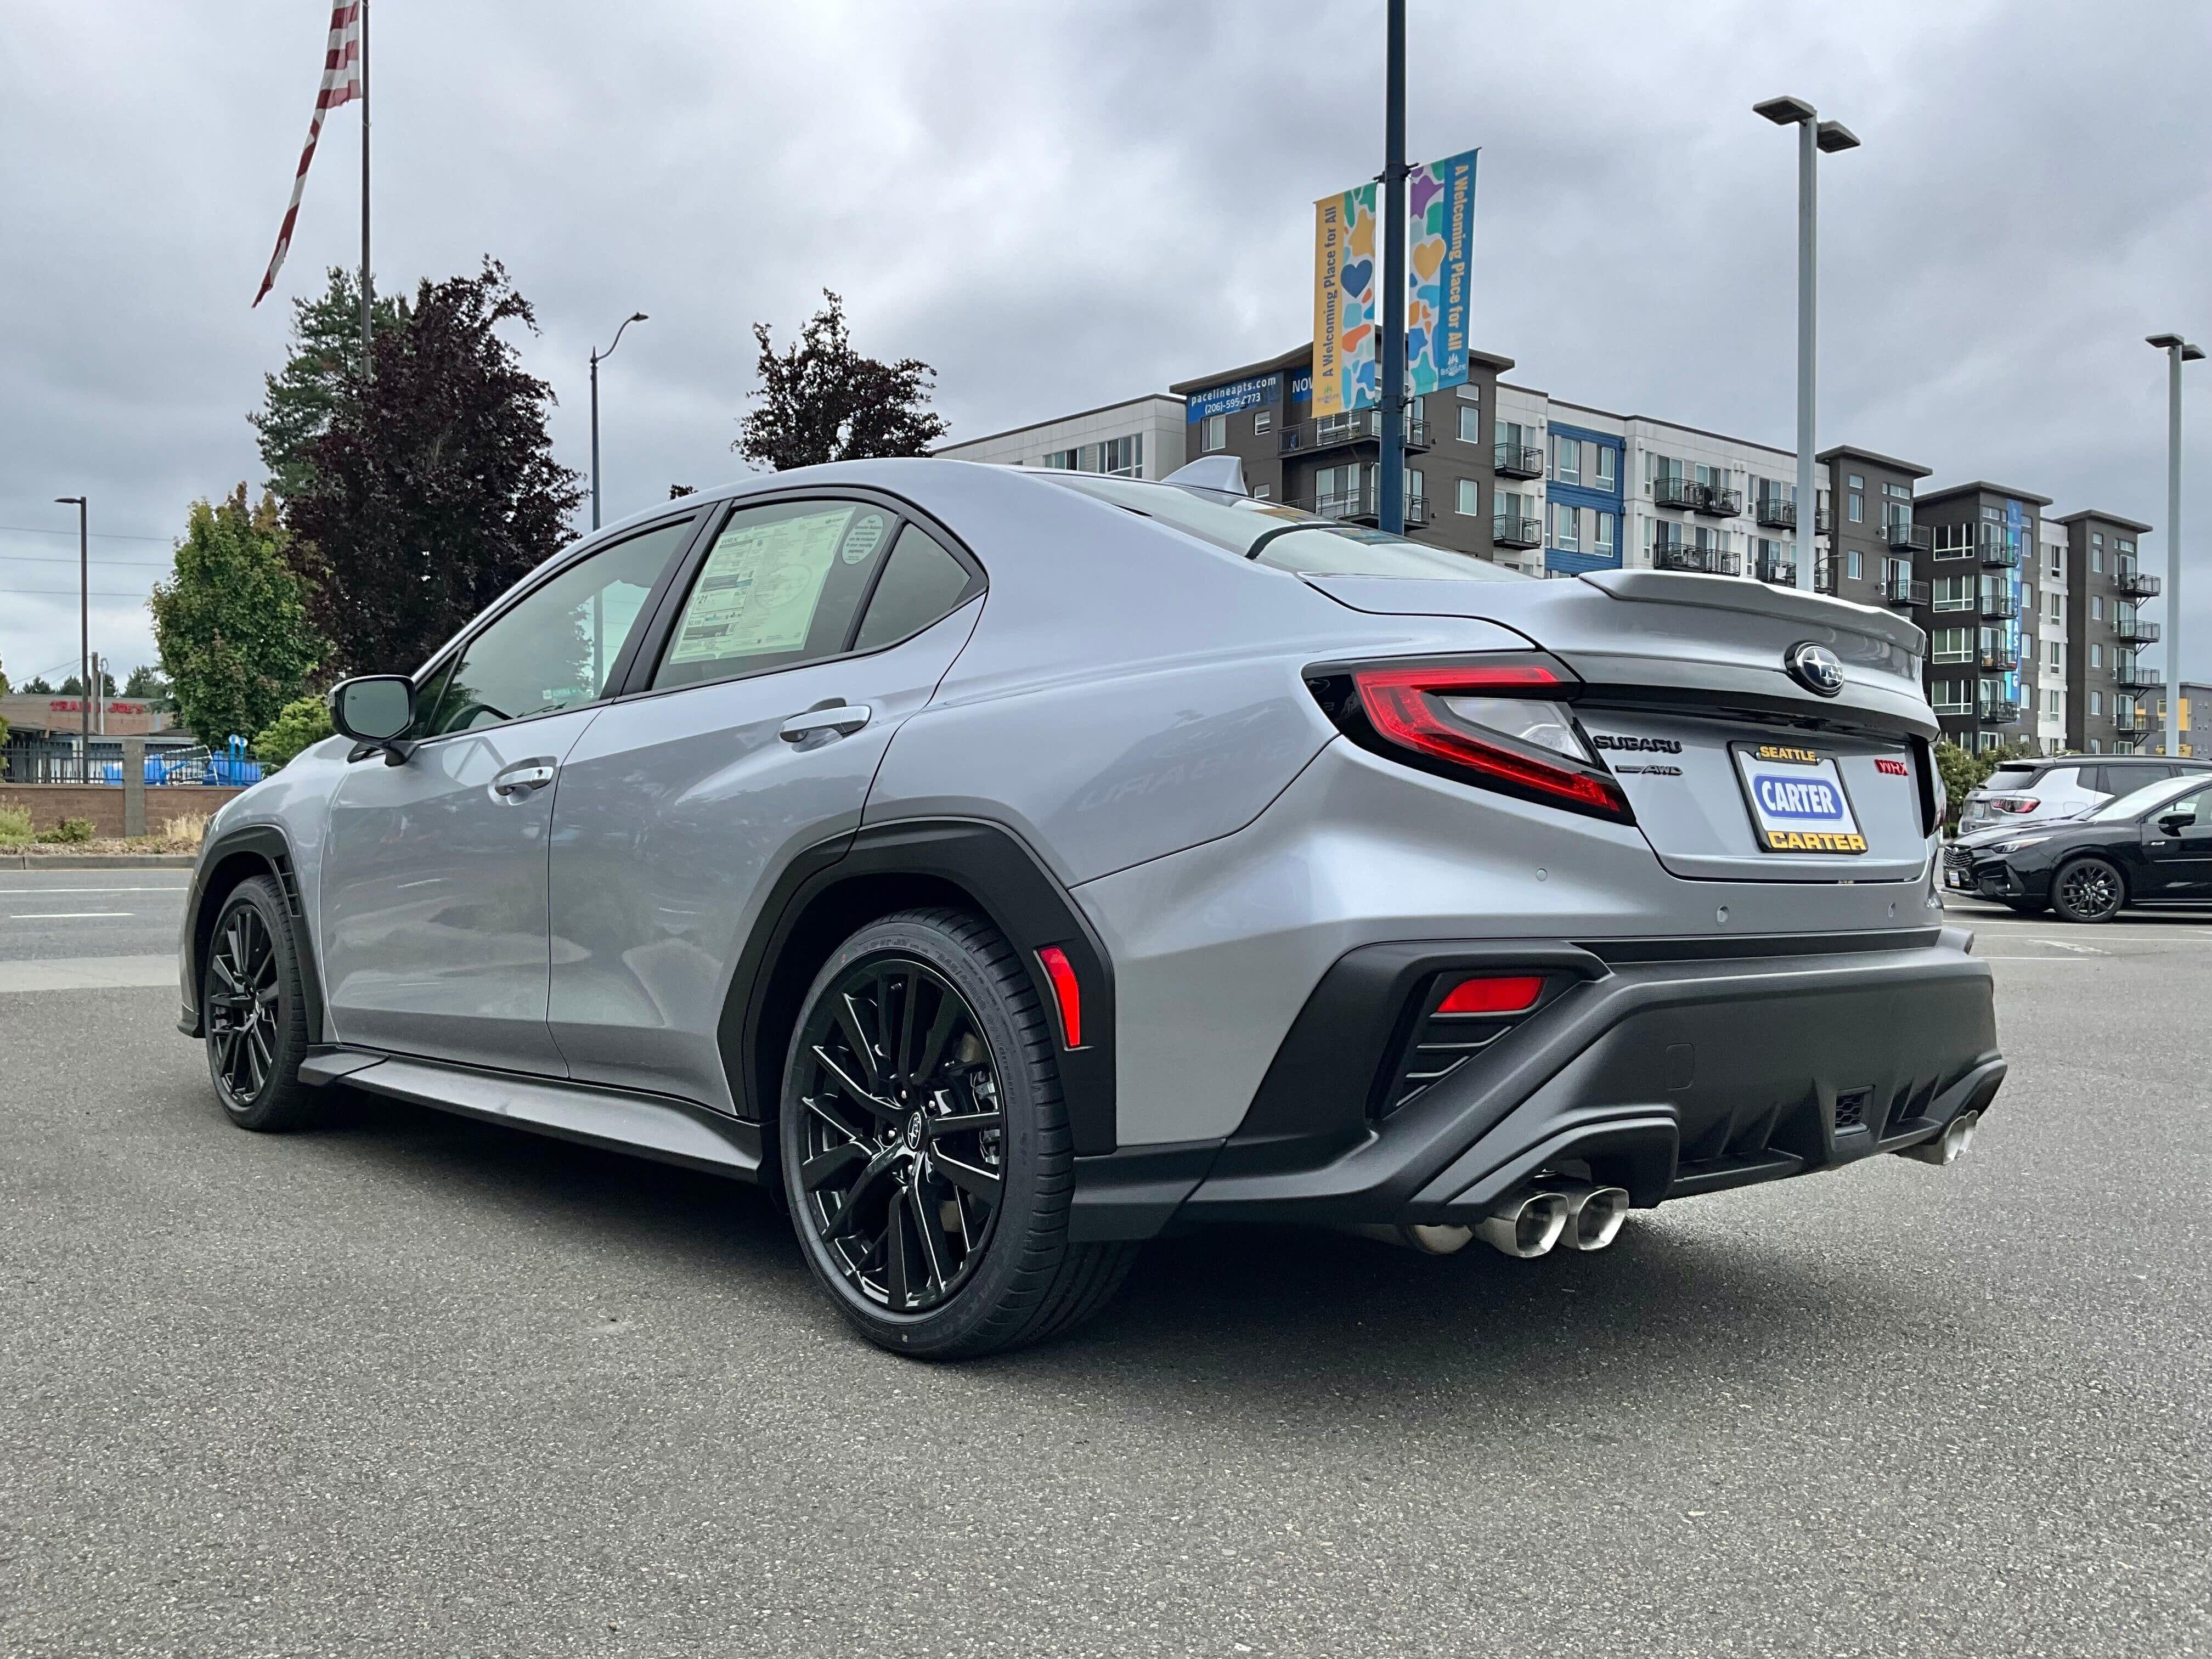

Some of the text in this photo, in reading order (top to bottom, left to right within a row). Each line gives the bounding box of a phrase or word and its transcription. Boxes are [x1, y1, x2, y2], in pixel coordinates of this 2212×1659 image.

[1447, 164, 1469, 352] A Welcoming Place for All
[1322, 206, 1338, 377] A Welcoming Place for All
[1191, 376, 1276, 407] pacelineapts.com
[721, 536, 741, 545] WRX
[1593, 735, 1683, 754] SUBARU
[1759, 746, 1817, 762] SEATTLE
[1641, 765, 1684, 776] AWD
[1761, 780, 1837, 814] CARTER
[1767, 831, 1866, 850] CARTER
